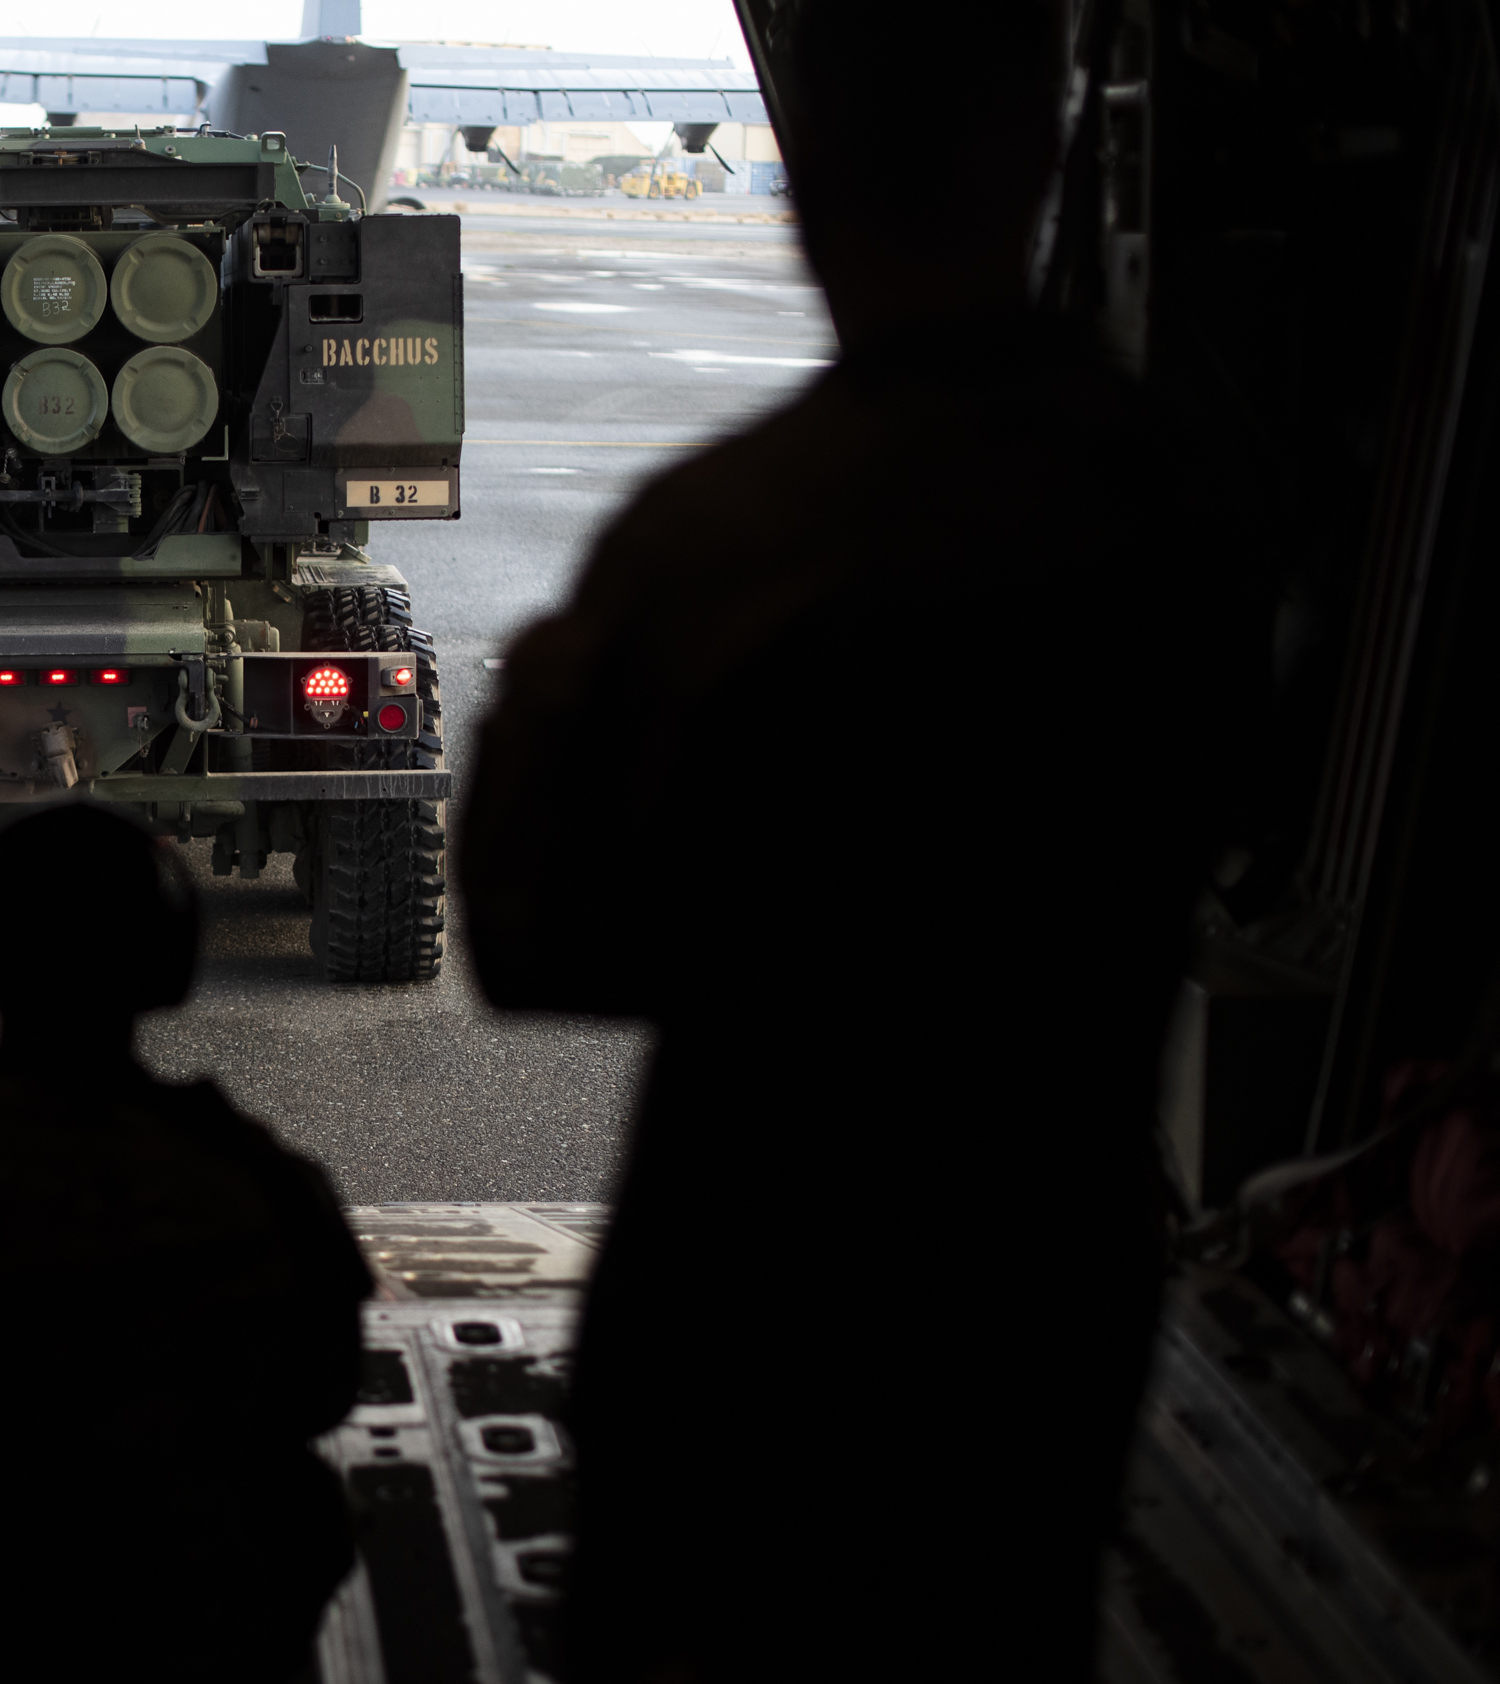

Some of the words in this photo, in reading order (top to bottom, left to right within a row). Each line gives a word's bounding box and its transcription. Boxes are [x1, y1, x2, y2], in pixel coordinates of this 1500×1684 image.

[42, 300, 72, 317] B32
[322, 337, 439, 367] BACCHUS
[39, 395, 75, 415] B32
[369, 485, 381, 504] B
[395, 484, 418, 503] 32
